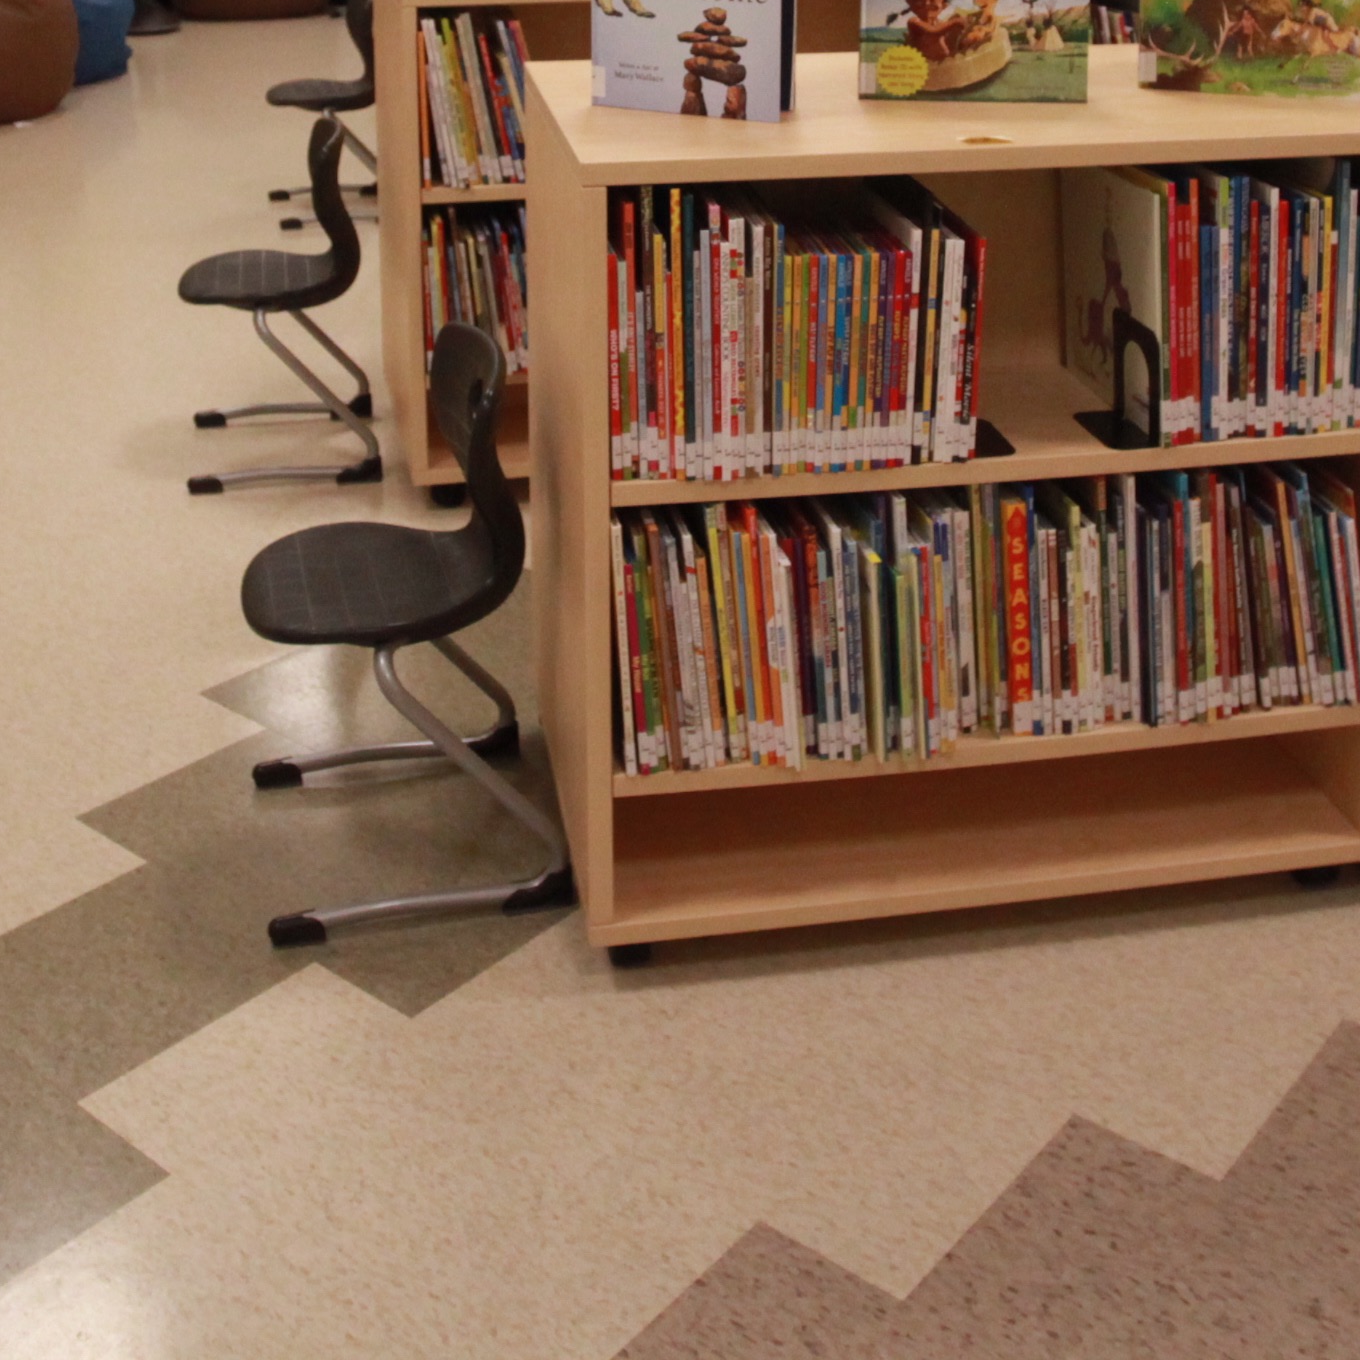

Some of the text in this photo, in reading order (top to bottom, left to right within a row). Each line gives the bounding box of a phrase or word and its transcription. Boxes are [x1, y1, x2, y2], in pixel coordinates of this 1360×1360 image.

[609, 329, 622, 411] WHO'S ON FIRST?
[963, 343, 975, 421] Silent Movie
[1011, 537, 1031, 703] SEASONS
